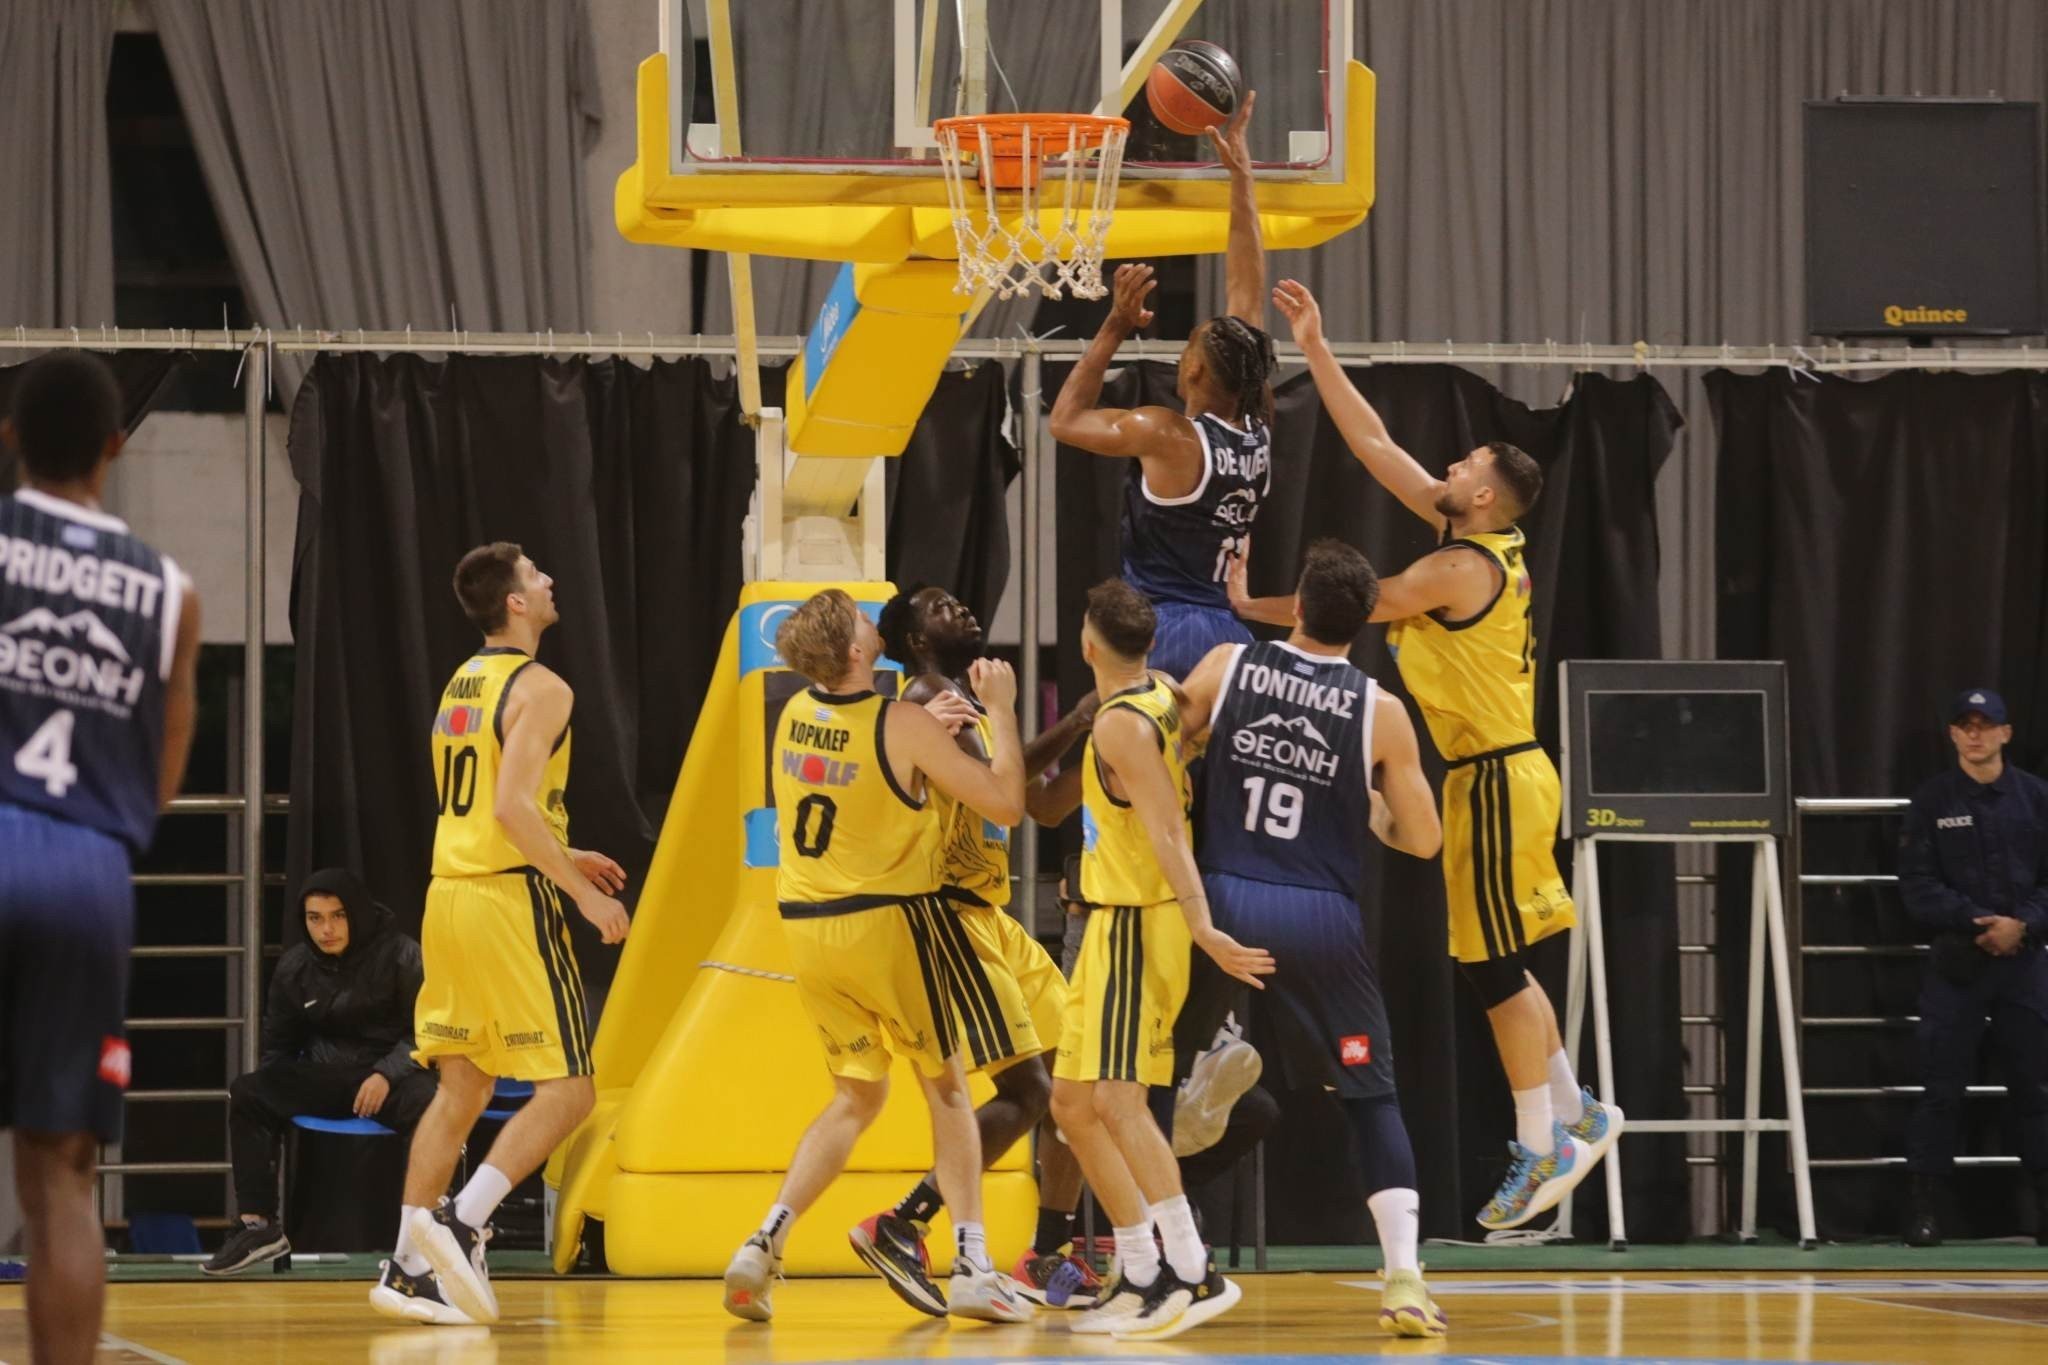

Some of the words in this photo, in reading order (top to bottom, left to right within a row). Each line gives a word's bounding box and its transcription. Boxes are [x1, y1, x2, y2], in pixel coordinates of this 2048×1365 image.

[1884, 305, 1967, 327] Quince
[1238, 663, 1358, 719] ΓΟΝΤΙΚΑΣ
[14, 709, 78, 798] 4
[782, 749, 860, 787] WOLF
[1232, 729, 1340, 778] ΘΕΟΝΗ
[439, 745, 478, 817] 10
[793, 793, 837, 859] 0
[1243, 776, 1305, 840] 19
[1586, 808, 1616, 827] 3D
[1937, 815, 1973, 829] POLICE
